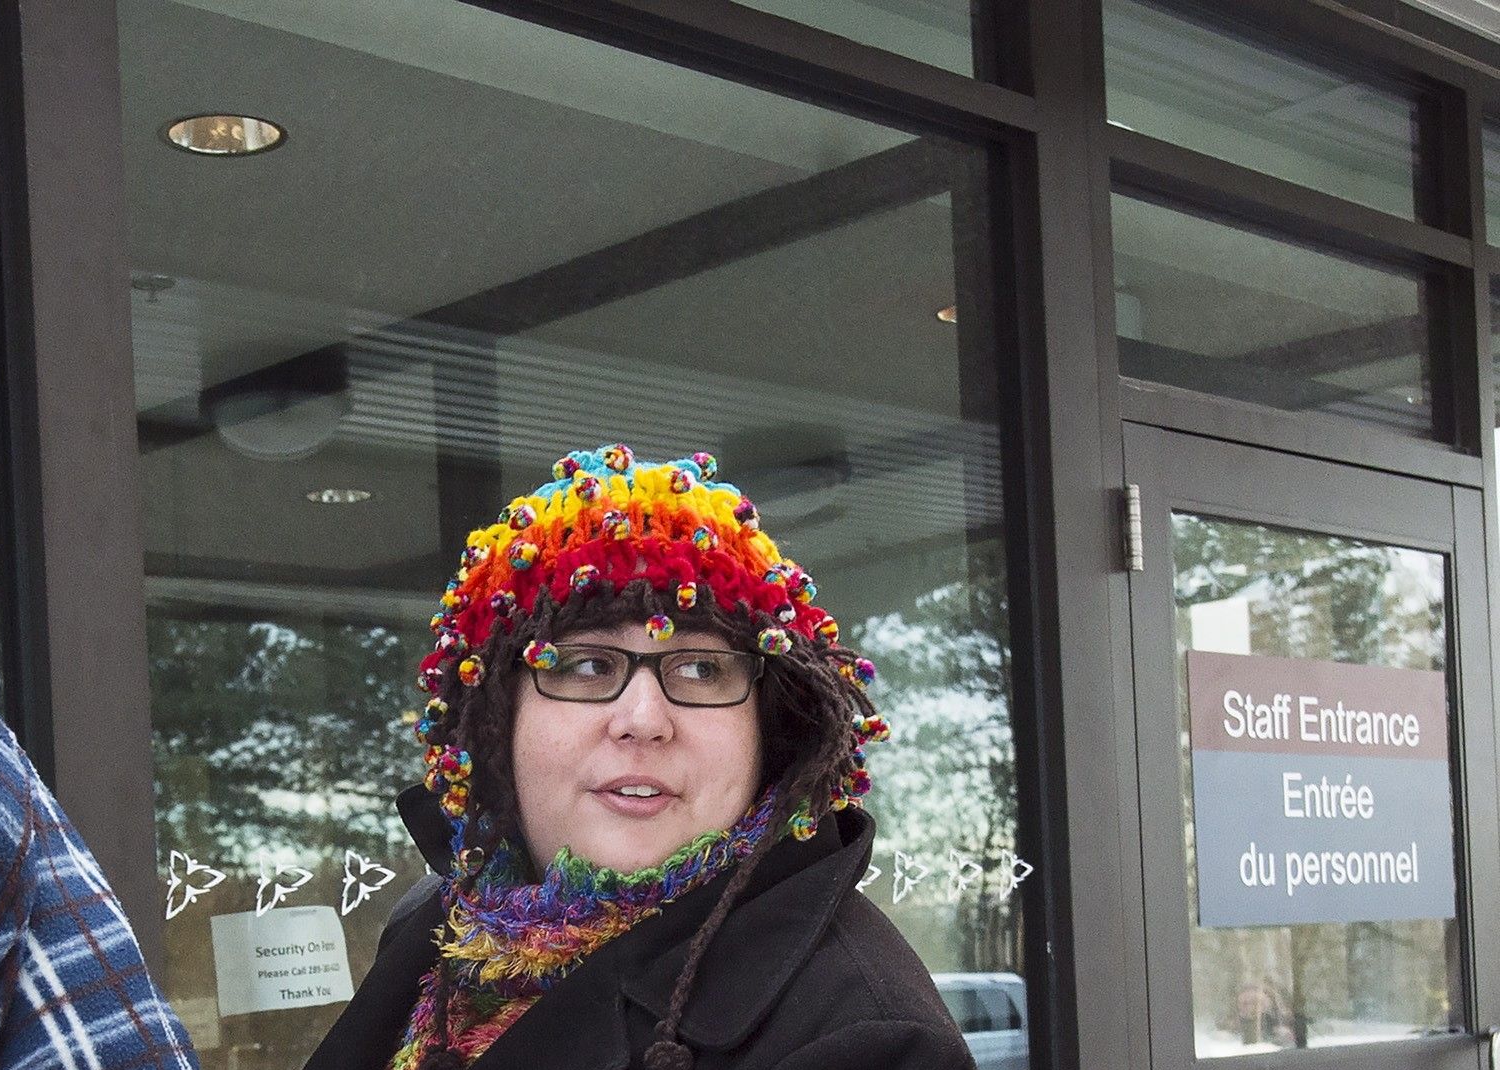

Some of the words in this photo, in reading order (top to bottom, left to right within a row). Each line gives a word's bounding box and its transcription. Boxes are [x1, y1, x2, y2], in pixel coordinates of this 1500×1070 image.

[1223, 689, 1292, 740] Staff
[1299, 695, 1420, 747] Entrance
[1282, 771, 1375, 820] Entrée
[1239, 841, 1276, 887] du
[1286, 841, 1419, 896] personnel
[255, 943, 305, 959] Security
[257, 969, 289, 979] Please
[291, 966, 307, 976] Call
[279, 986, 314, 1000] Thank
[315, 985, 332, 996] You
